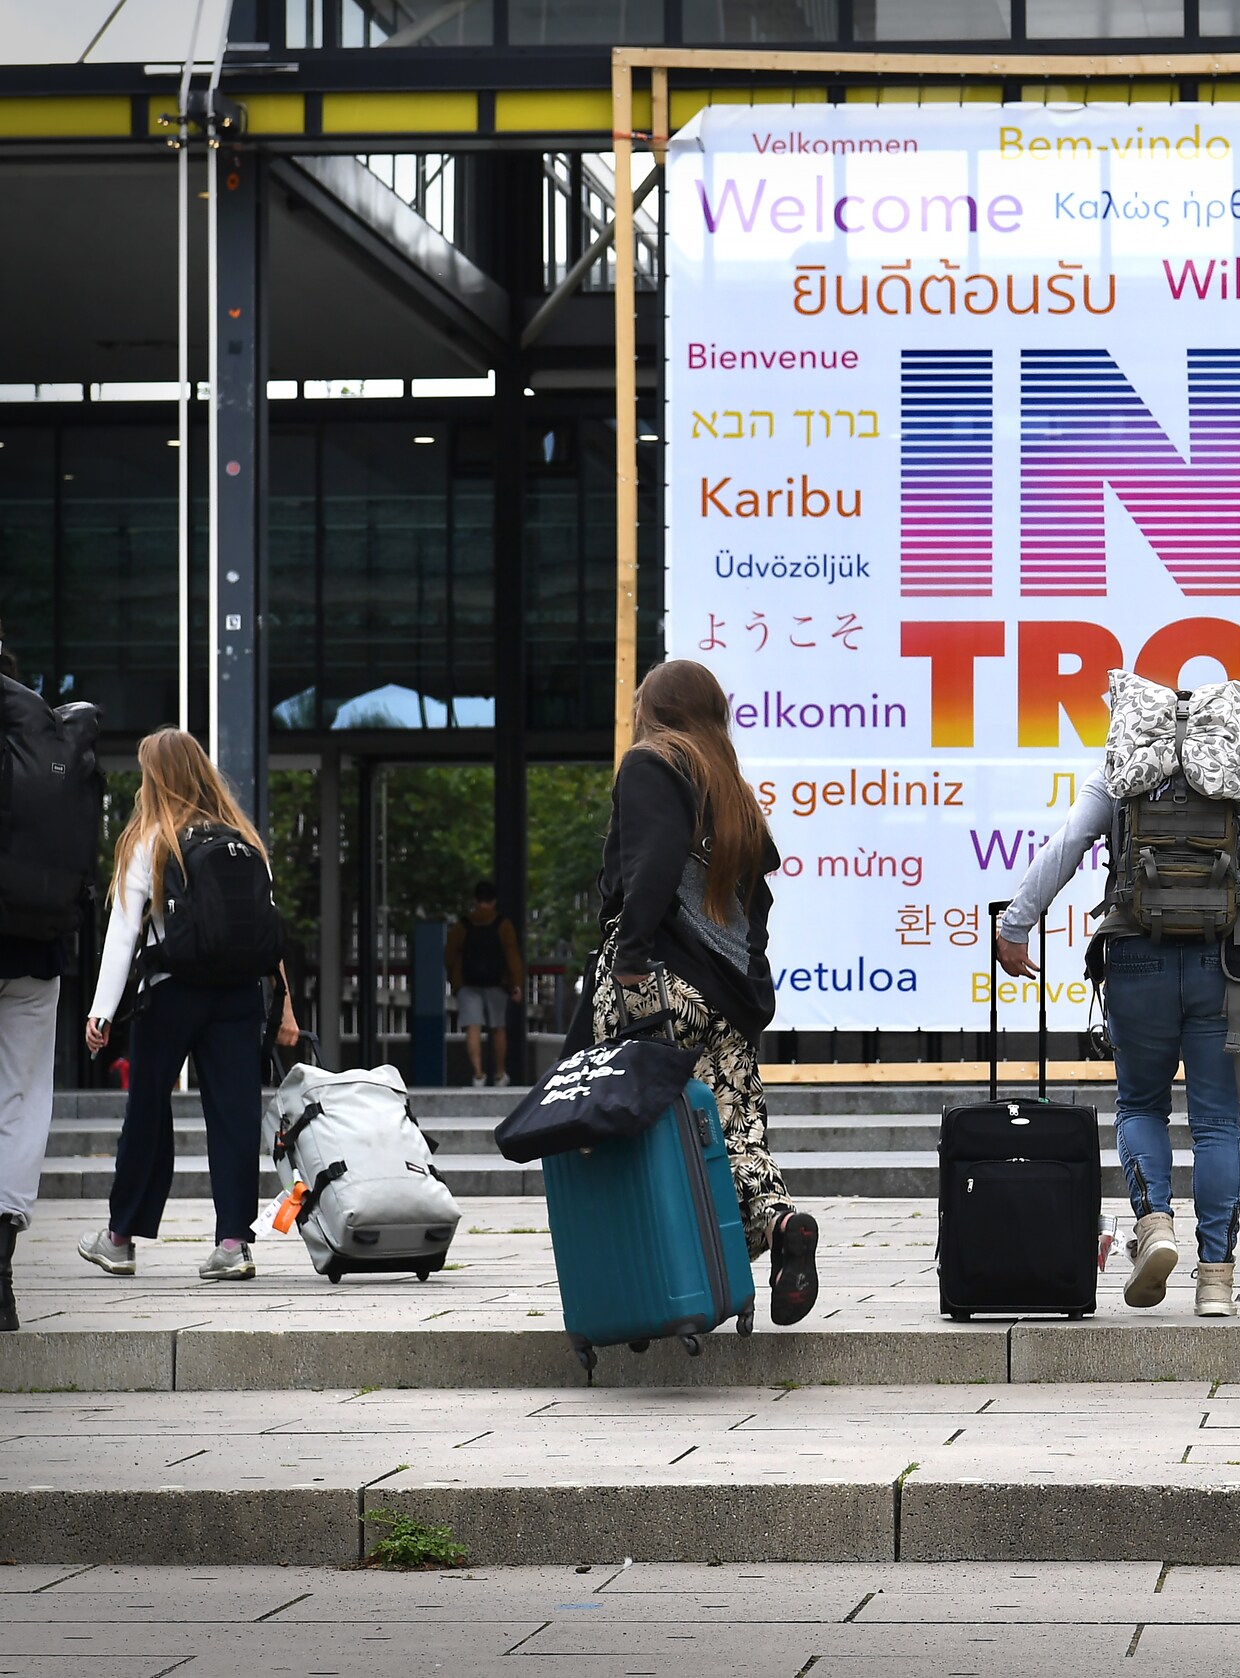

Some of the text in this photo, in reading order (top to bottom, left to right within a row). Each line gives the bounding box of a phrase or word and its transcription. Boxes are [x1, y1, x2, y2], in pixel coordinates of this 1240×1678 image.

[752, 132, 919, 155] Velkommen
[999, 124, 1231, 161] Bem-vindo
[694, 175, 1024, 234] Welcome
[687, 343, 859, 370] Bienvenue
[692, 409, 880, 447] ברוך הבא
[701, 474, 862, 518] Karibu
[715, 549, 871, 585] Üdvözöljük
[698, 611, 864, 653] ようこそ
[734, 690, 907, 729] elkomin
[791, 768, 964, 817] geldiniz
[817, 846, 924, 887] mừng
